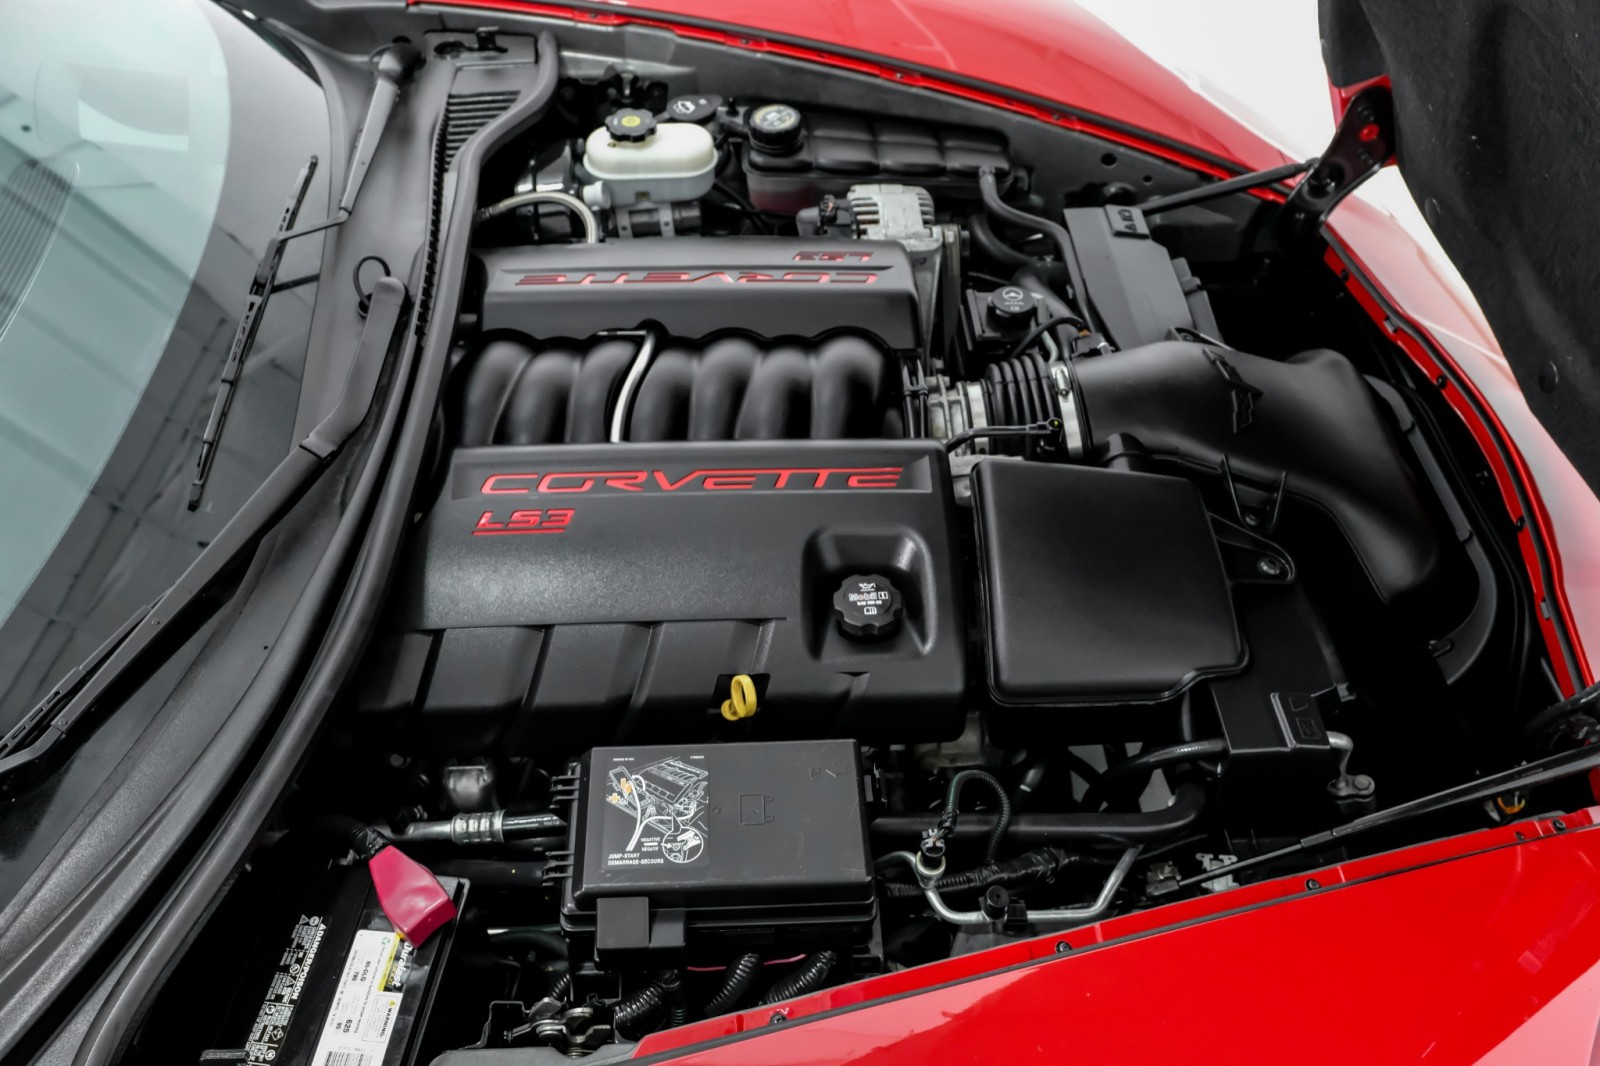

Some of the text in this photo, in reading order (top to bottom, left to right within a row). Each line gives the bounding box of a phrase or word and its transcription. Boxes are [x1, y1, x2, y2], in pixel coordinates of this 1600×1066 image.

[792, 250, 874, 261] LS3
[515, 271, 878, 285] CORVETTE
[480, 467, 903, 495] CORVETTE
[472, 508, 575, 536] LS3
[291, 930, 324, 1000] DANGER/POISON
[392, 941, 412, 987] Duralast
[343, 1019, 352, 1033] 625
